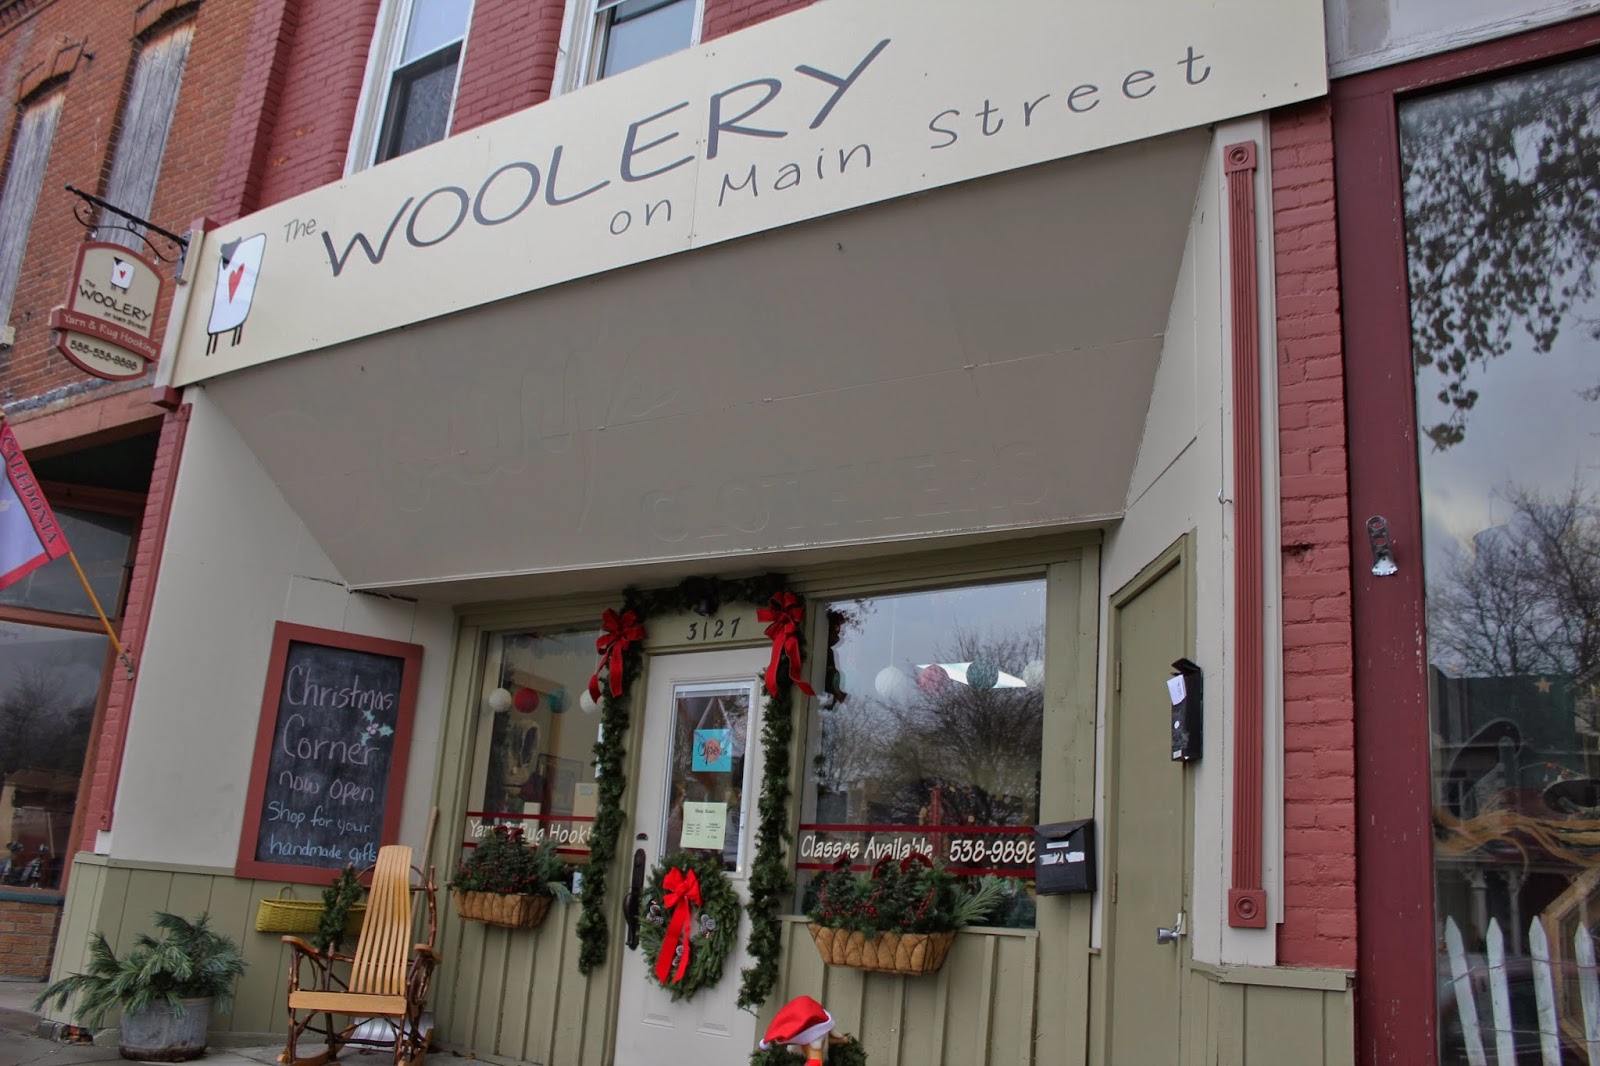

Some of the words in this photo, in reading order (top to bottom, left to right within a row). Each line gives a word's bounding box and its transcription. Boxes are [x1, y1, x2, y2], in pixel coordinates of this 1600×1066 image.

[321, 38, 891, 277] WOOLERY
[609, 199, 673, 236] on
[717, 142, 873, 207] Main
[928, 45, 1212, 150] Street
[284, 217, 318, 243] The
[80, 284, 152, 321] WOOLERY
[63, 313, 86, 328] Yarn
[88, 320, 97, 331] &
[99, 324, 119, 339] Rug
[120, 331, 157, 357] Hooking
[2, 436, 58, 545] CALEDONIA
[686, 617, 742, 641] 3127
[286, 665, 394, 710] Christmas
[282, 713, 380, 766] Corner
[267, 800, 306, 828] Shop
[310, 805, 333, 828] for
[337, 819, 371, 836] your
[470, 819, 498, 839] Yar
[549, 824, 598, 845] Hooki
[268, 834, 342, 860] handmade
[348, 841, 377, 866] gifts
[800, 835, 860, 859] Classes
